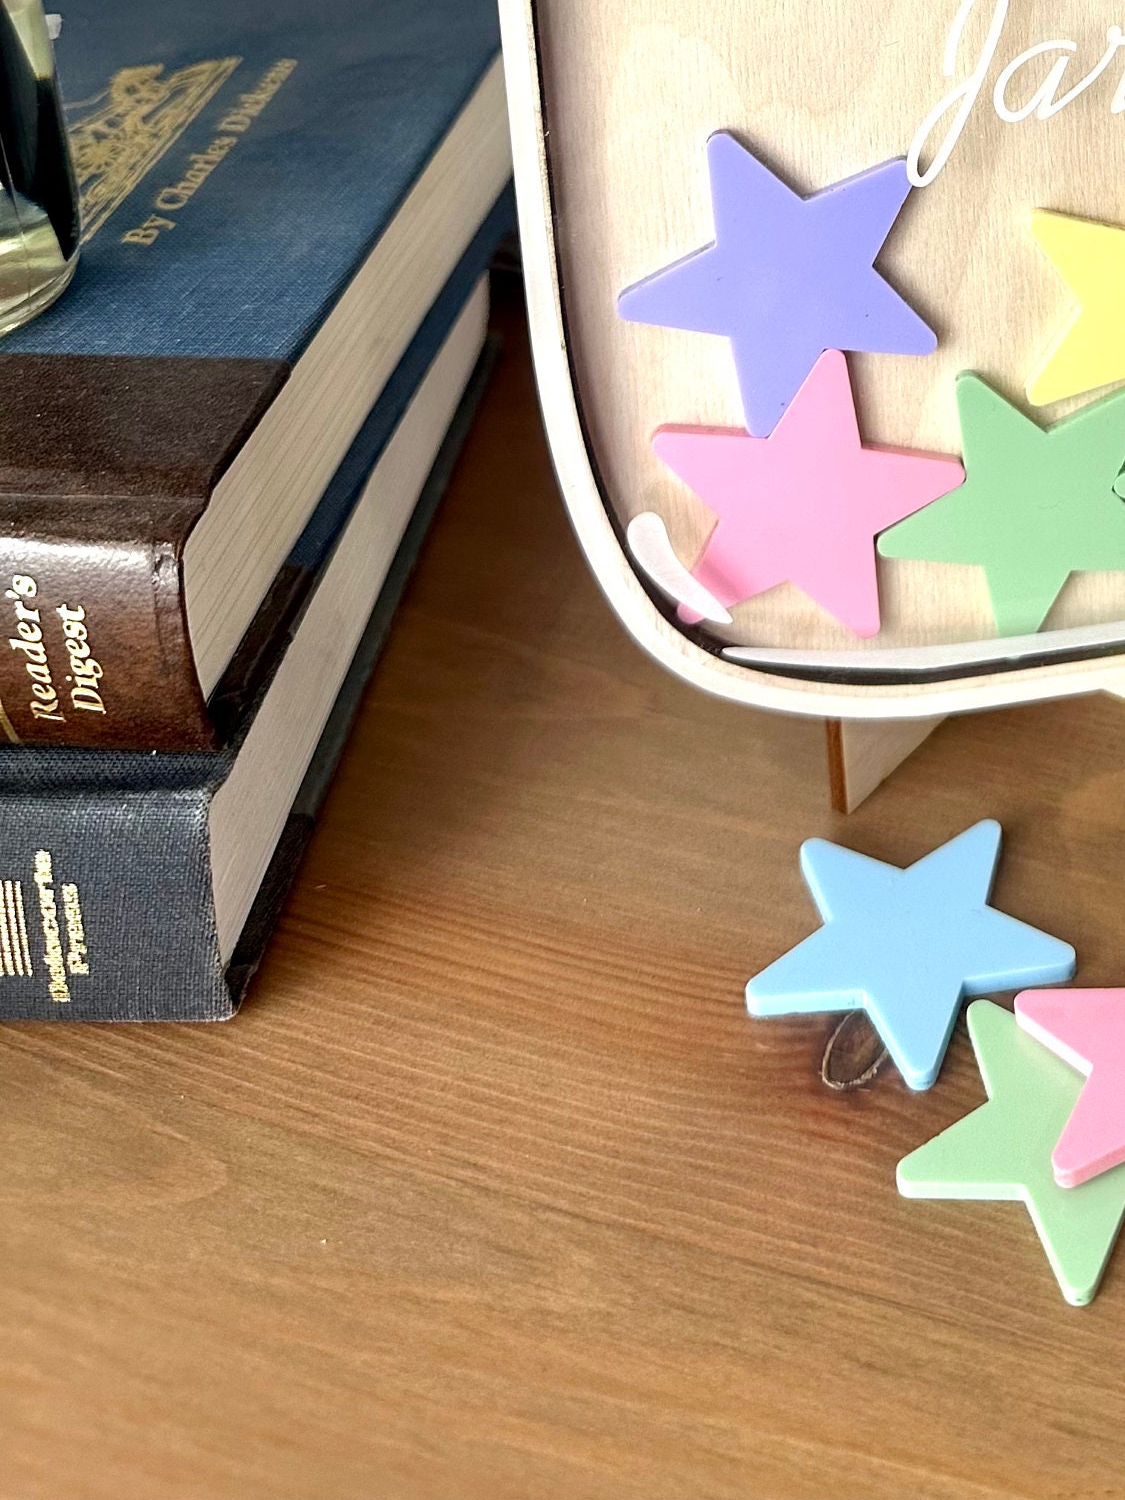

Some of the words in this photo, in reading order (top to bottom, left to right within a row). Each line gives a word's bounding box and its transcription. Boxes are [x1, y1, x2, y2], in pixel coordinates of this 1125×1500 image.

[122, 214, 176, 246] By
[156, 135, 238, 211] Charles
[216, 59, 299, 133] Dickens
[5, 574, 67, 723] Reader's
[55, 603, 107, 715] Digest
[61, 882, 90, 975] Press
